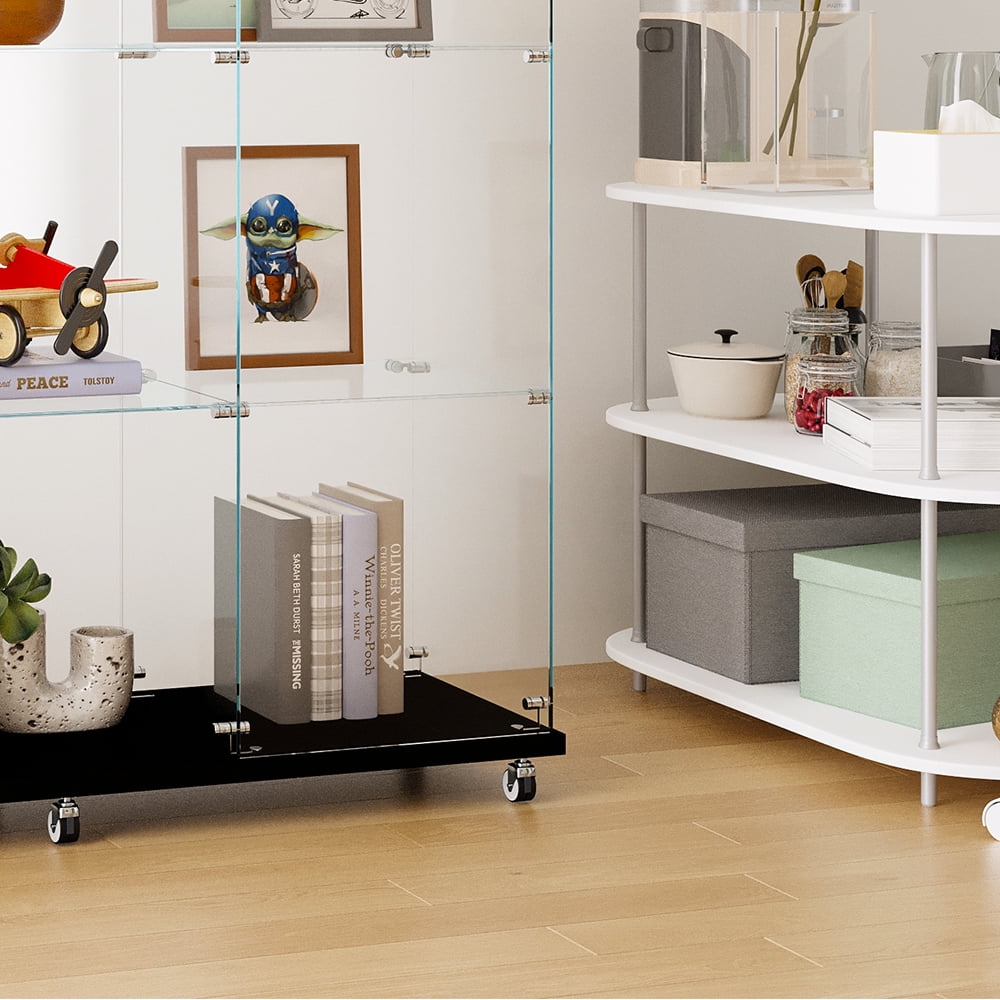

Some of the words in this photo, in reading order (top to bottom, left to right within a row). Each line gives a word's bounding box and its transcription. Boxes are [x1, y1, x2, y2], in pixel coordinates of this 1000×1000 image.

[17, 376, 69, 391] PEACE
[83, 377, 115, 386] TOLSTOY
[292, 553, 300, 581] SARAH
[390, 544, 401, 596] OLIVER
[292, 583, 300, 604] BETH
[292, 607, 300, 634] DURST
[363, 555, 375, 676] Winnie-the-Pooh
[390, 598, 401, 641] TWIST
[292, 646, 301, 689] MISSING
